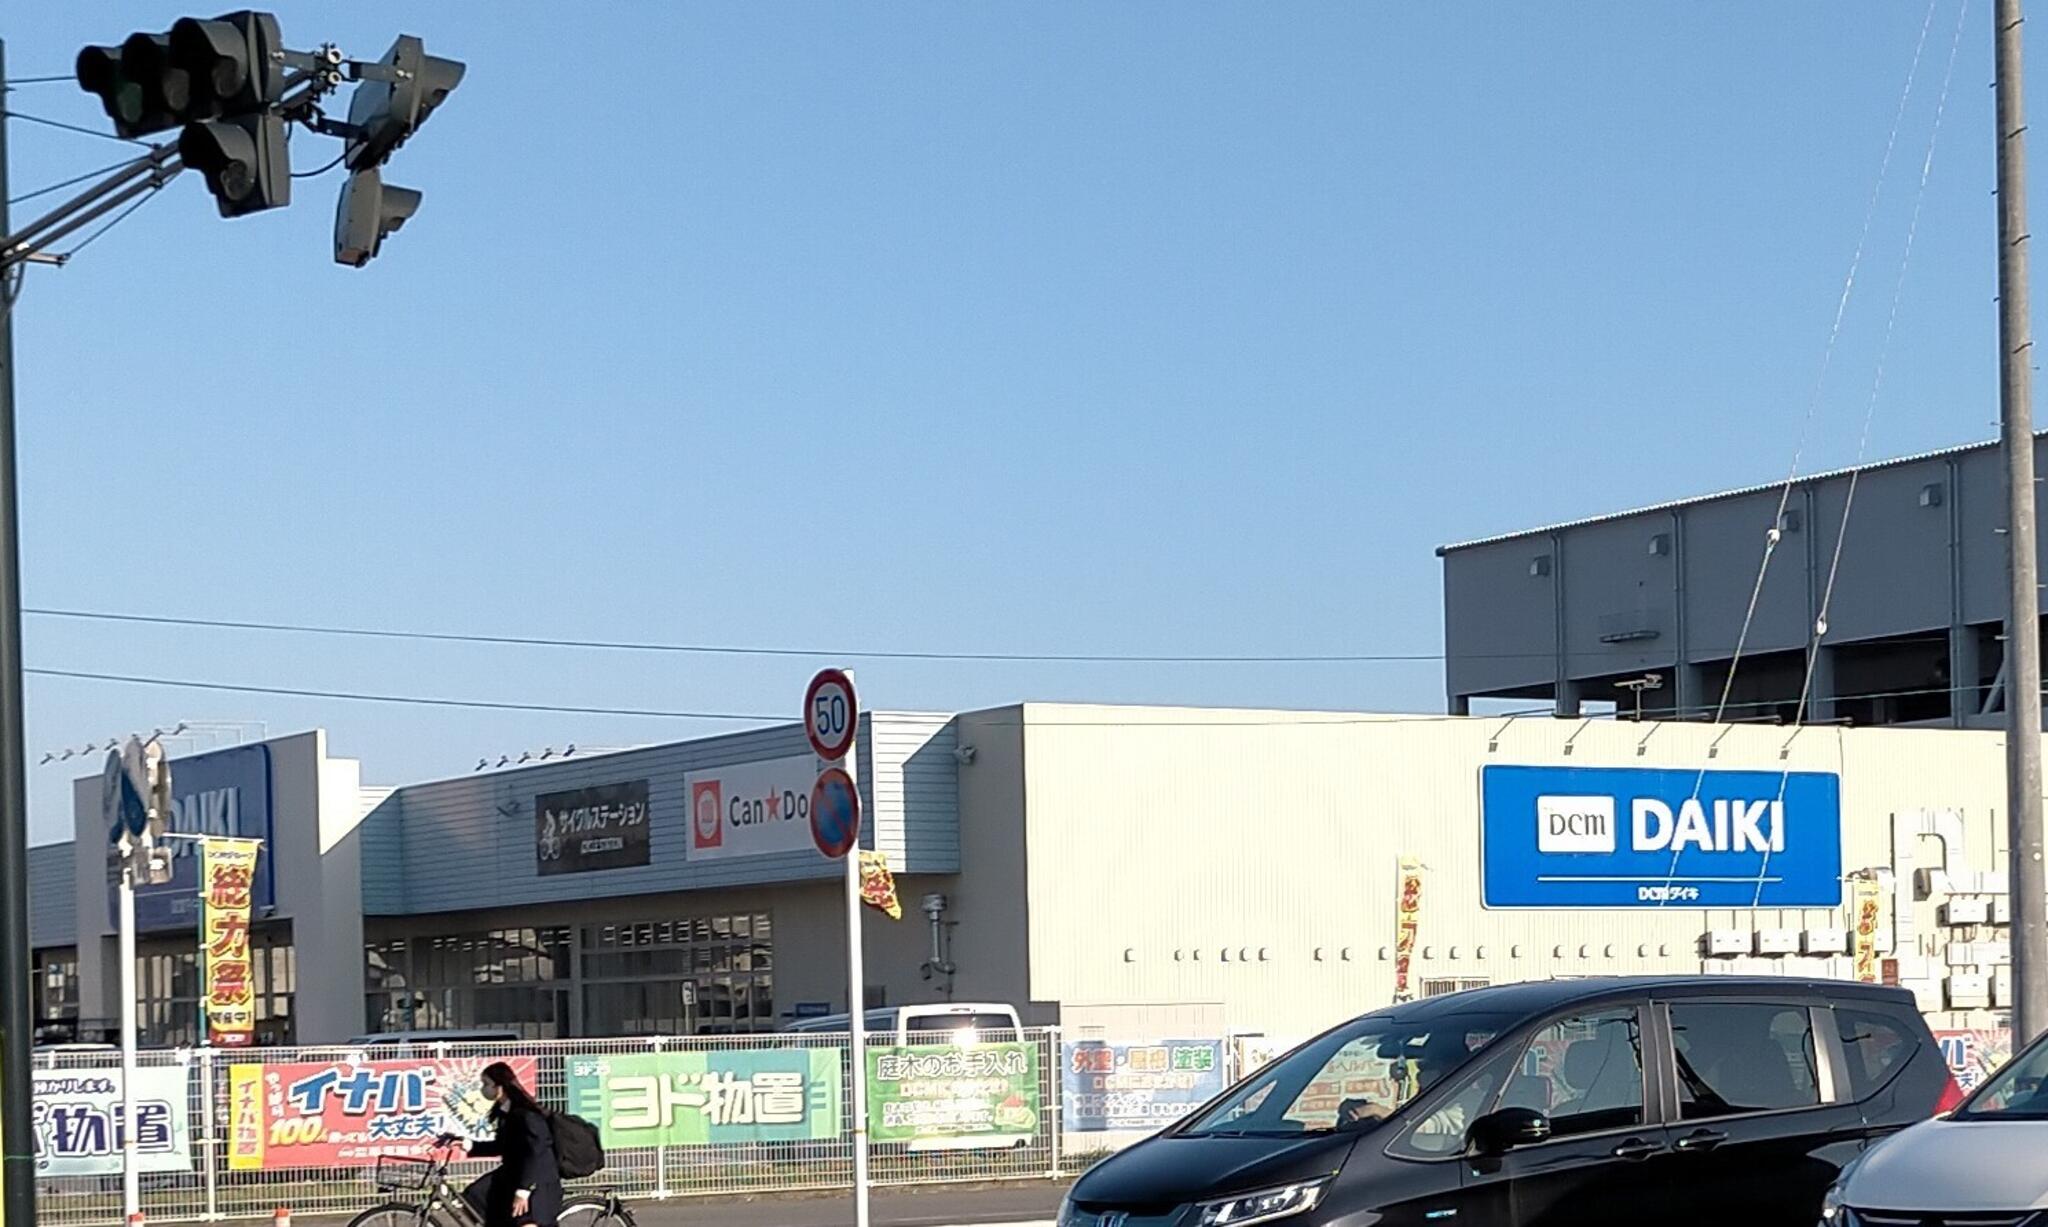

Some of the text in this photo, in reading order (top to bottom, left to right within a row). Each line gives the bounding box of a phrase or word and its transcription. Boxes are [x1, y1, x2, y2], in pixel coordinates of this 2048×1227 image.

[816, 694, 846, 736] 50
[559, 802, 646, 834] サイクルステーション
[1549, 798, 1785, 852] DCM DAIKI
[1638, 886, 1700, 901] DCMダイキ
[208, 864, 251, 1005] 総力祭
[878, 1051, 1029, 1081] 庭木のお手入れ
[288, 1066, 436, 1117] イナバ
[607, 1071, 804, 1130] ヨド物置
